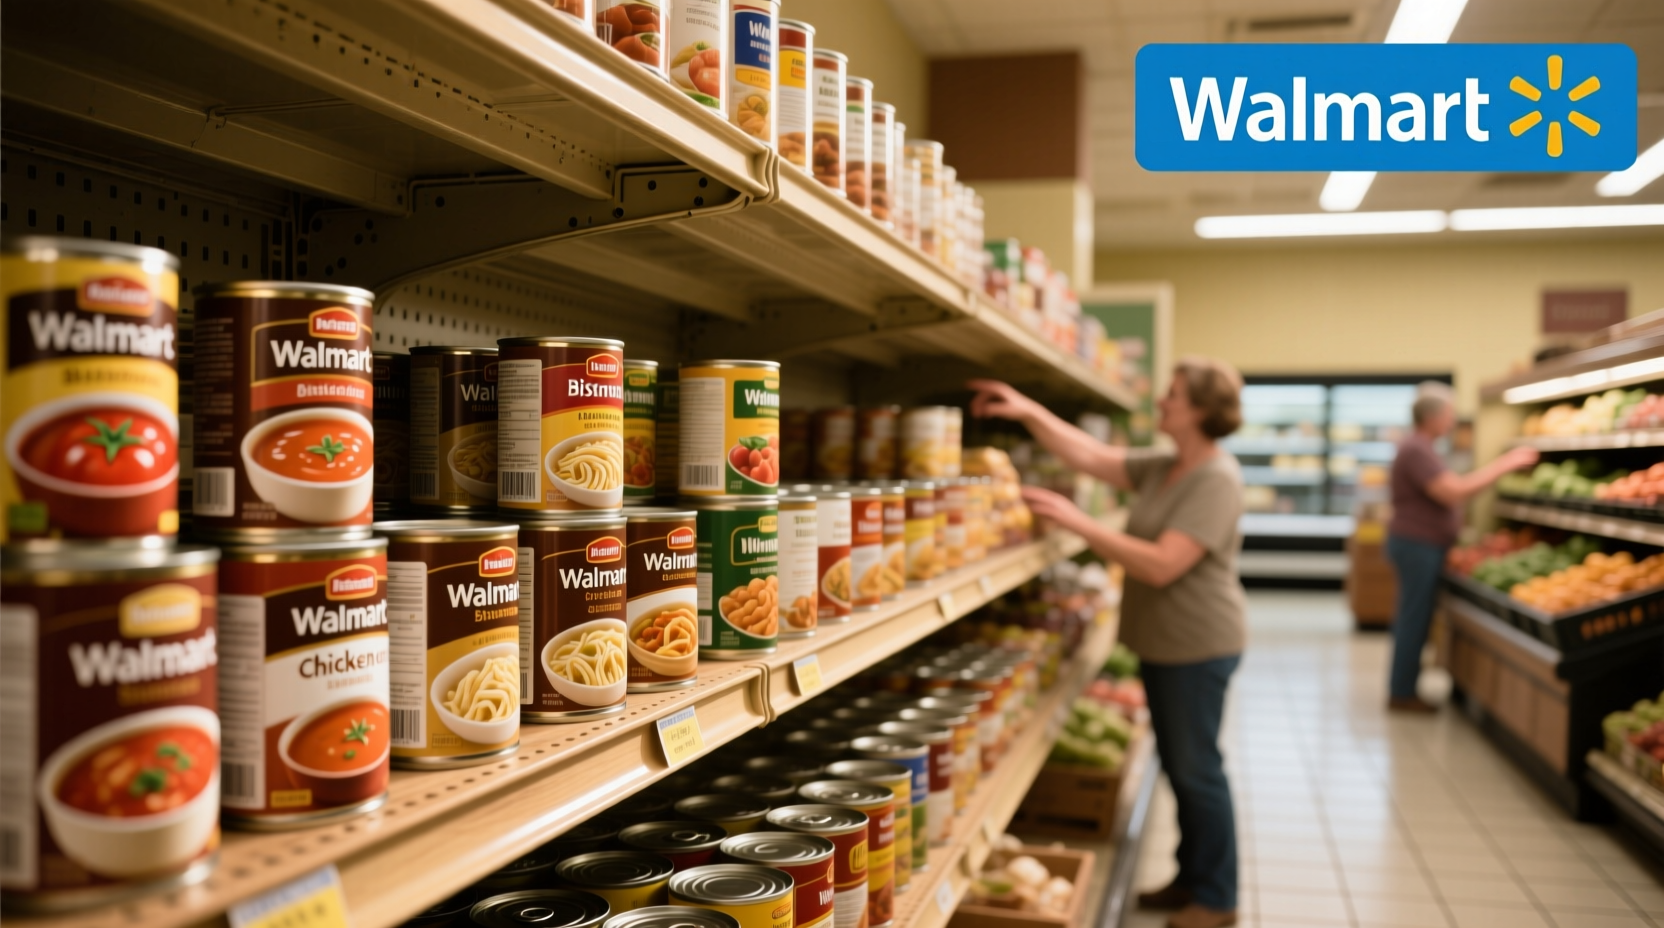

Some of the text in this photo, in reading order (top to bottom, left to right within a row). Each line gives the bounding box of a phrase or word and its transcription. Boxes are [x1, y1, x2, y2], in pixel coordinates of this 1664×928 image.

[28, 310, 176, 360] Walmart
[270, 340, 372, 373] Walmart
[461, 384, 498, 401] Wal
[291, 599, 387, 636] Walmart
[68, 627, 217, 687] Walmart
[299, 649, 374, 678] Chicken
